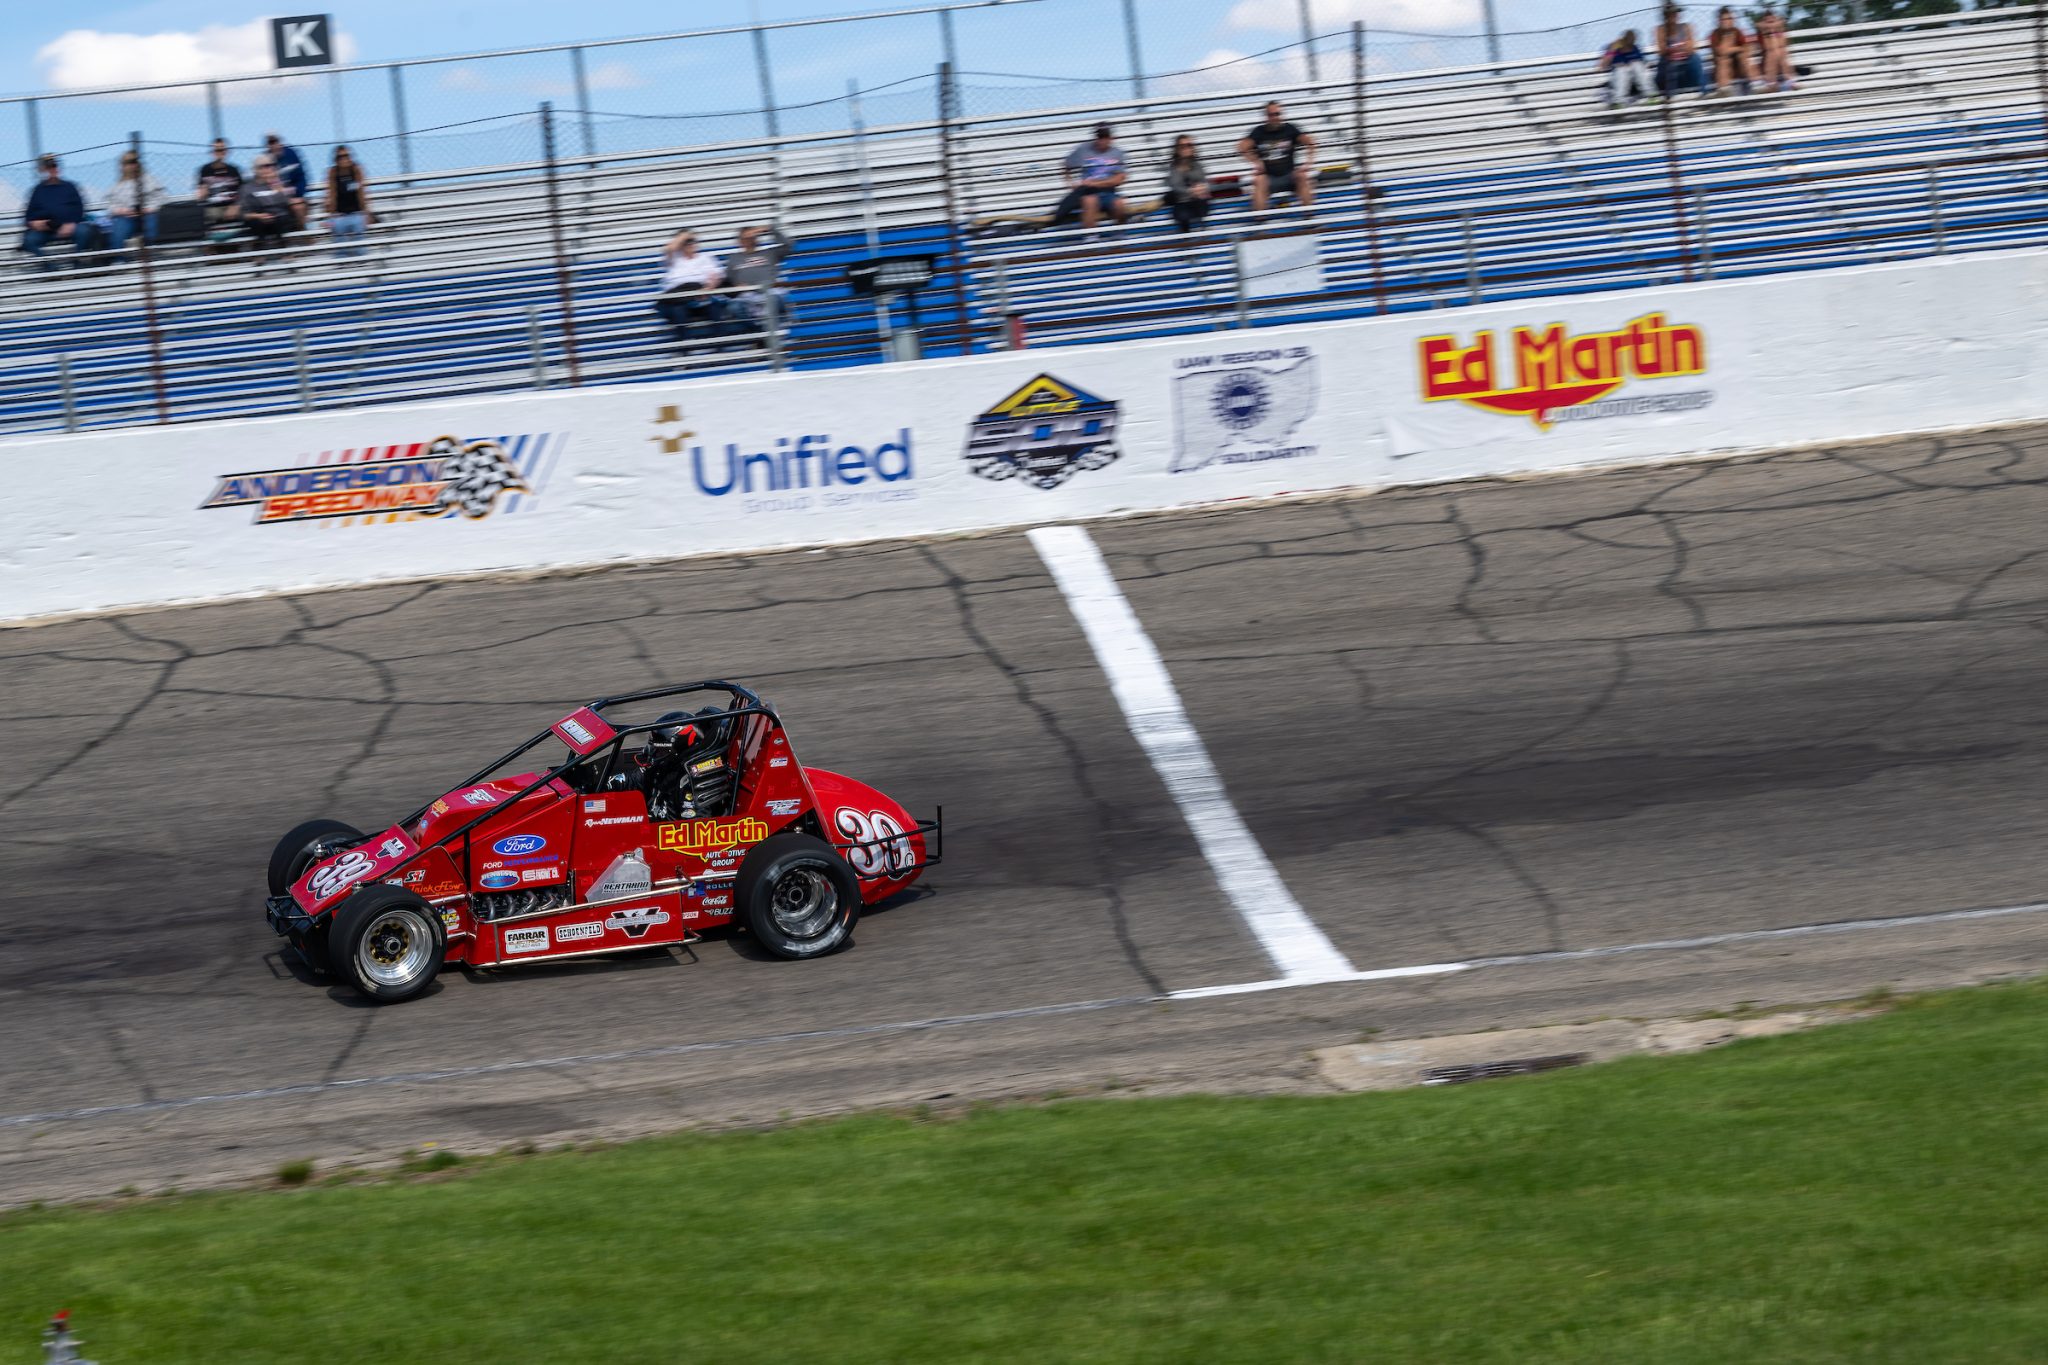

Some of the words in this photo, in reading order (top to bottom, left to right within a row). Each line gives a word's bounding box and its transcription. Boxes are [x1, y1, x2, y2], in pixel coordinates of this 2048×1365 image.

[282, 20, 325, 58] K
[1418, 333, 1494, 401] Ed
[1512, 312, 1707, 392] Martin
[689, 427, 914, 496] Unified
[217, 462, 441, 501] ANDERSON
[261, 484, 448, 521] SPEEDWAY
[600, 815, 644, 826] NEWMAN
[659, 823, 690, 850] Ed
[694, 817, 768, 848] Martin
[504, 837, 535, 853] Ford
[483, 861, 503, 870] FORD
[711, 859, 735, 868] GROUP
[702, 895, 728, 905] Coca-Cola
[714, 907, 734, 916] BUZZ
[508, 931, 545, 942] FARRAR
[559, 924, 601, 938] SCHOENFELD
